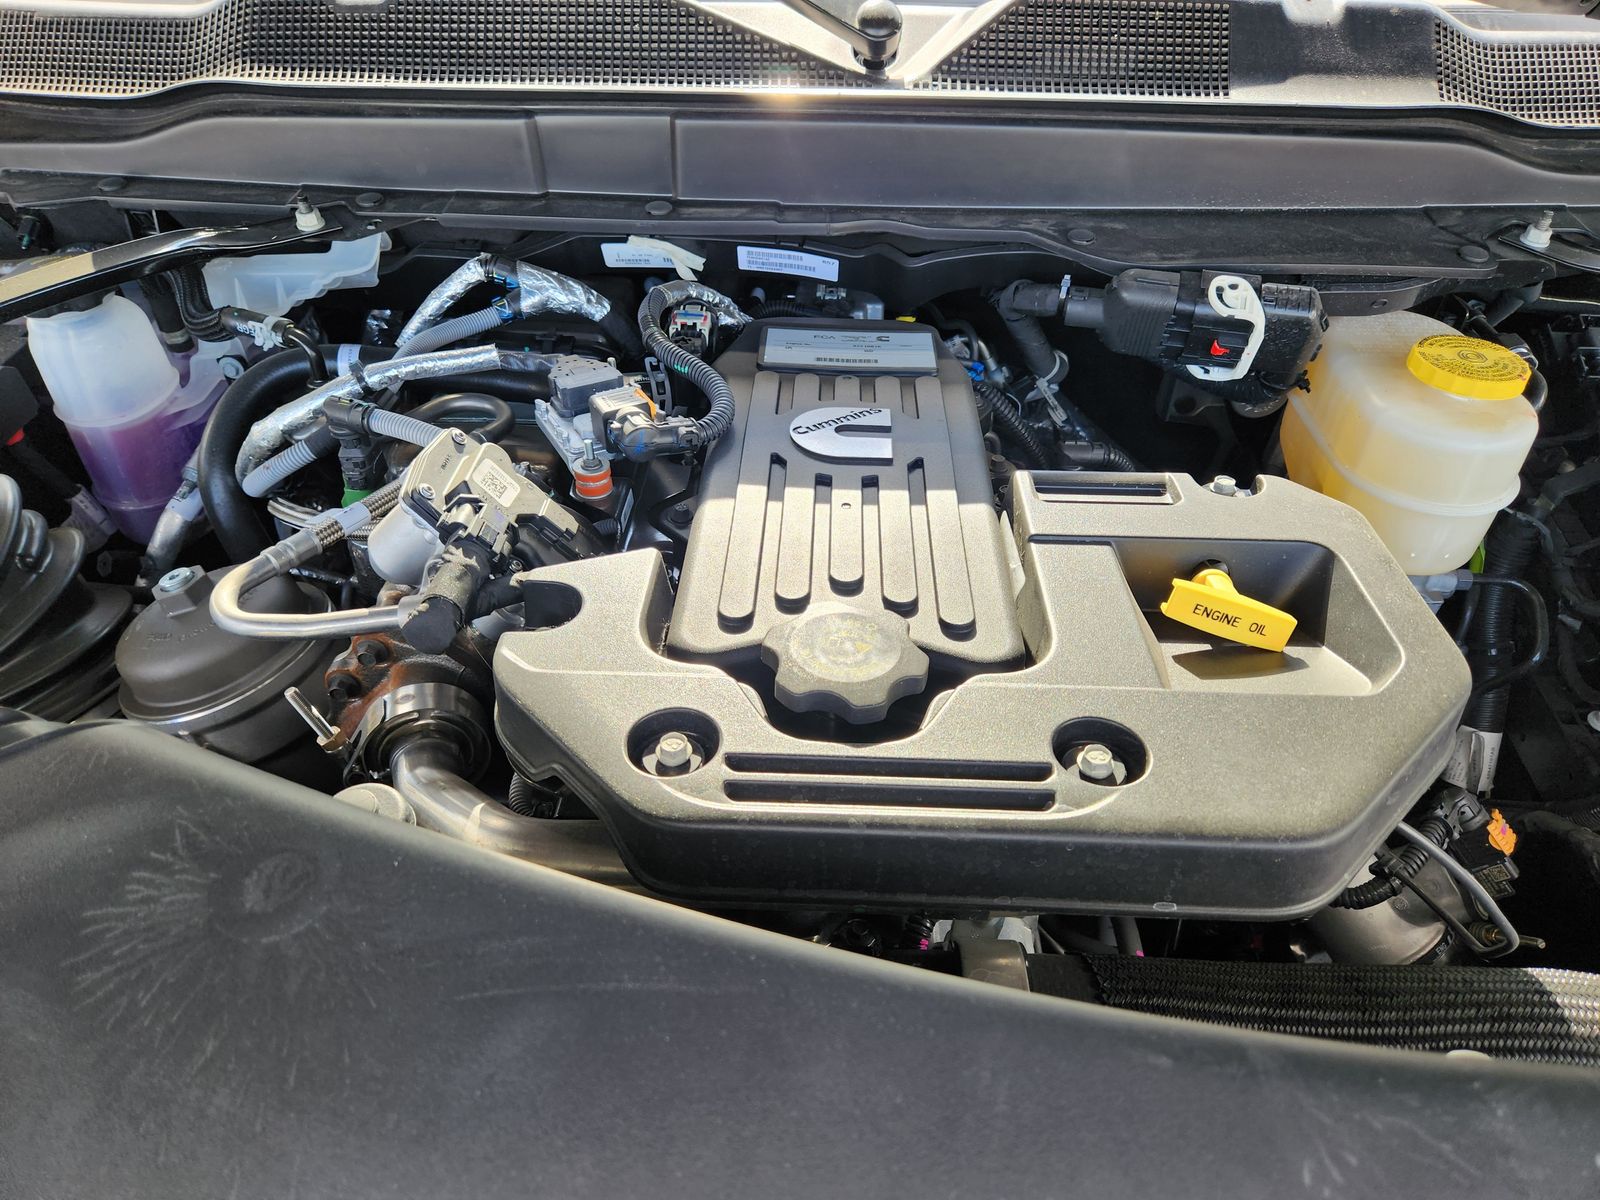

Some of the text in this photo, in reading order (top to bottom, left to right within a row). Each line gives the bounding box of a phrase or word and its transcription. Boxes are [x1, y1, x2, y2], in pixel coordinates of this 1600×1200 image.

[792, 407, 883, 436] Cummins
[1192, 603, 1267, 637] ENGINE OIL
